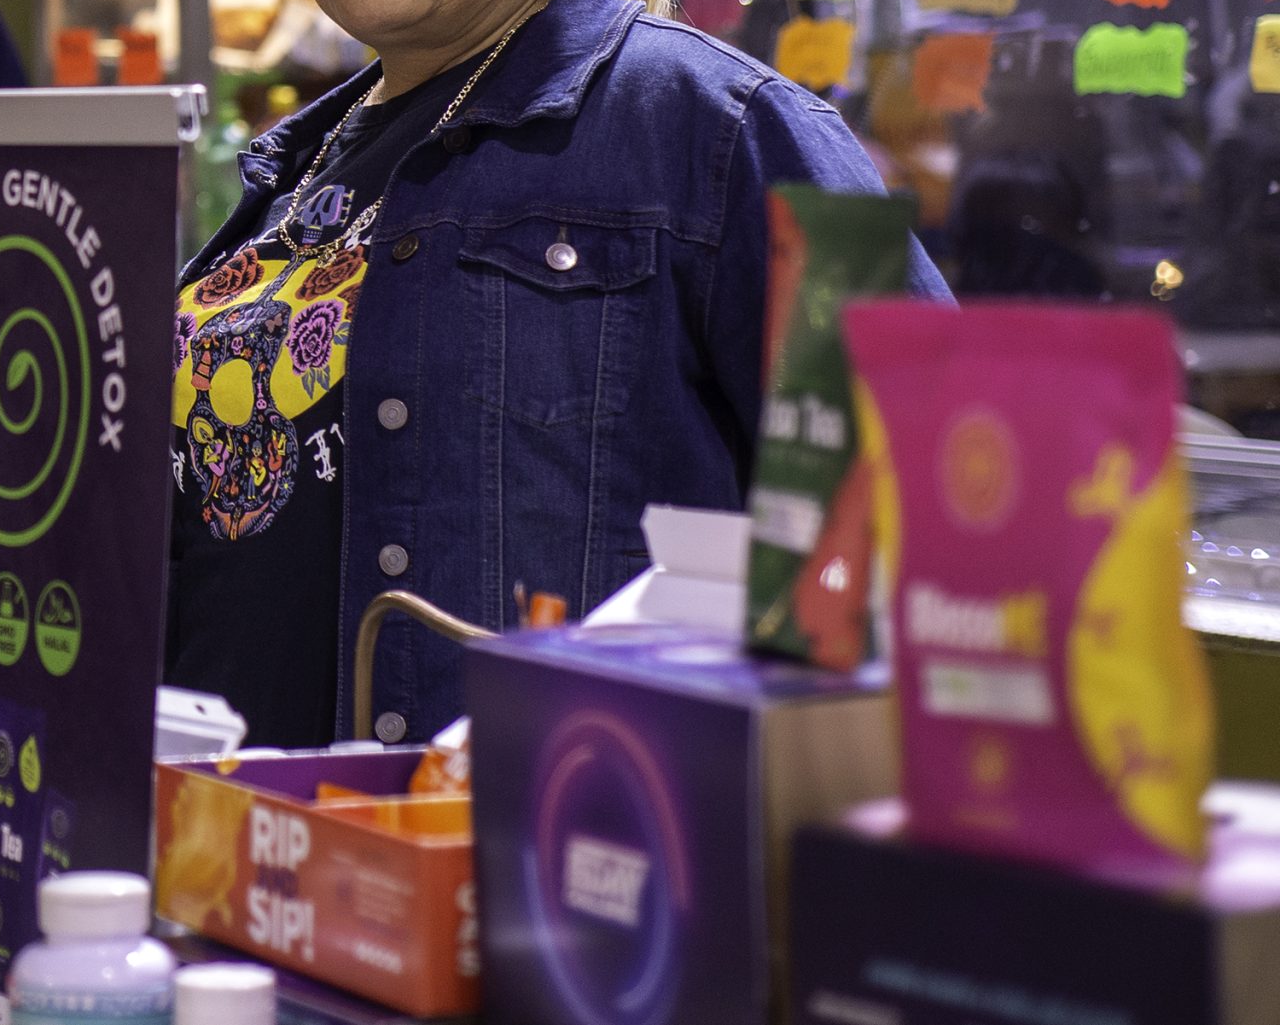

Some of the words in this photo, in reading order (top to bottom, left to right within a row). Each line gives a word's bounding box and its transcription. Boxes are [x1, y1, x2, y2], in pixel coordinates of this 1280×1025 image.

[2, 169, 101, 269] GENTLE
[90, 266, 126, 452] DETOX
[1, 822, 23, 863] Tea
[250, 805, 311, 870] RIP
[247, 885, 315, 962] SIP!
